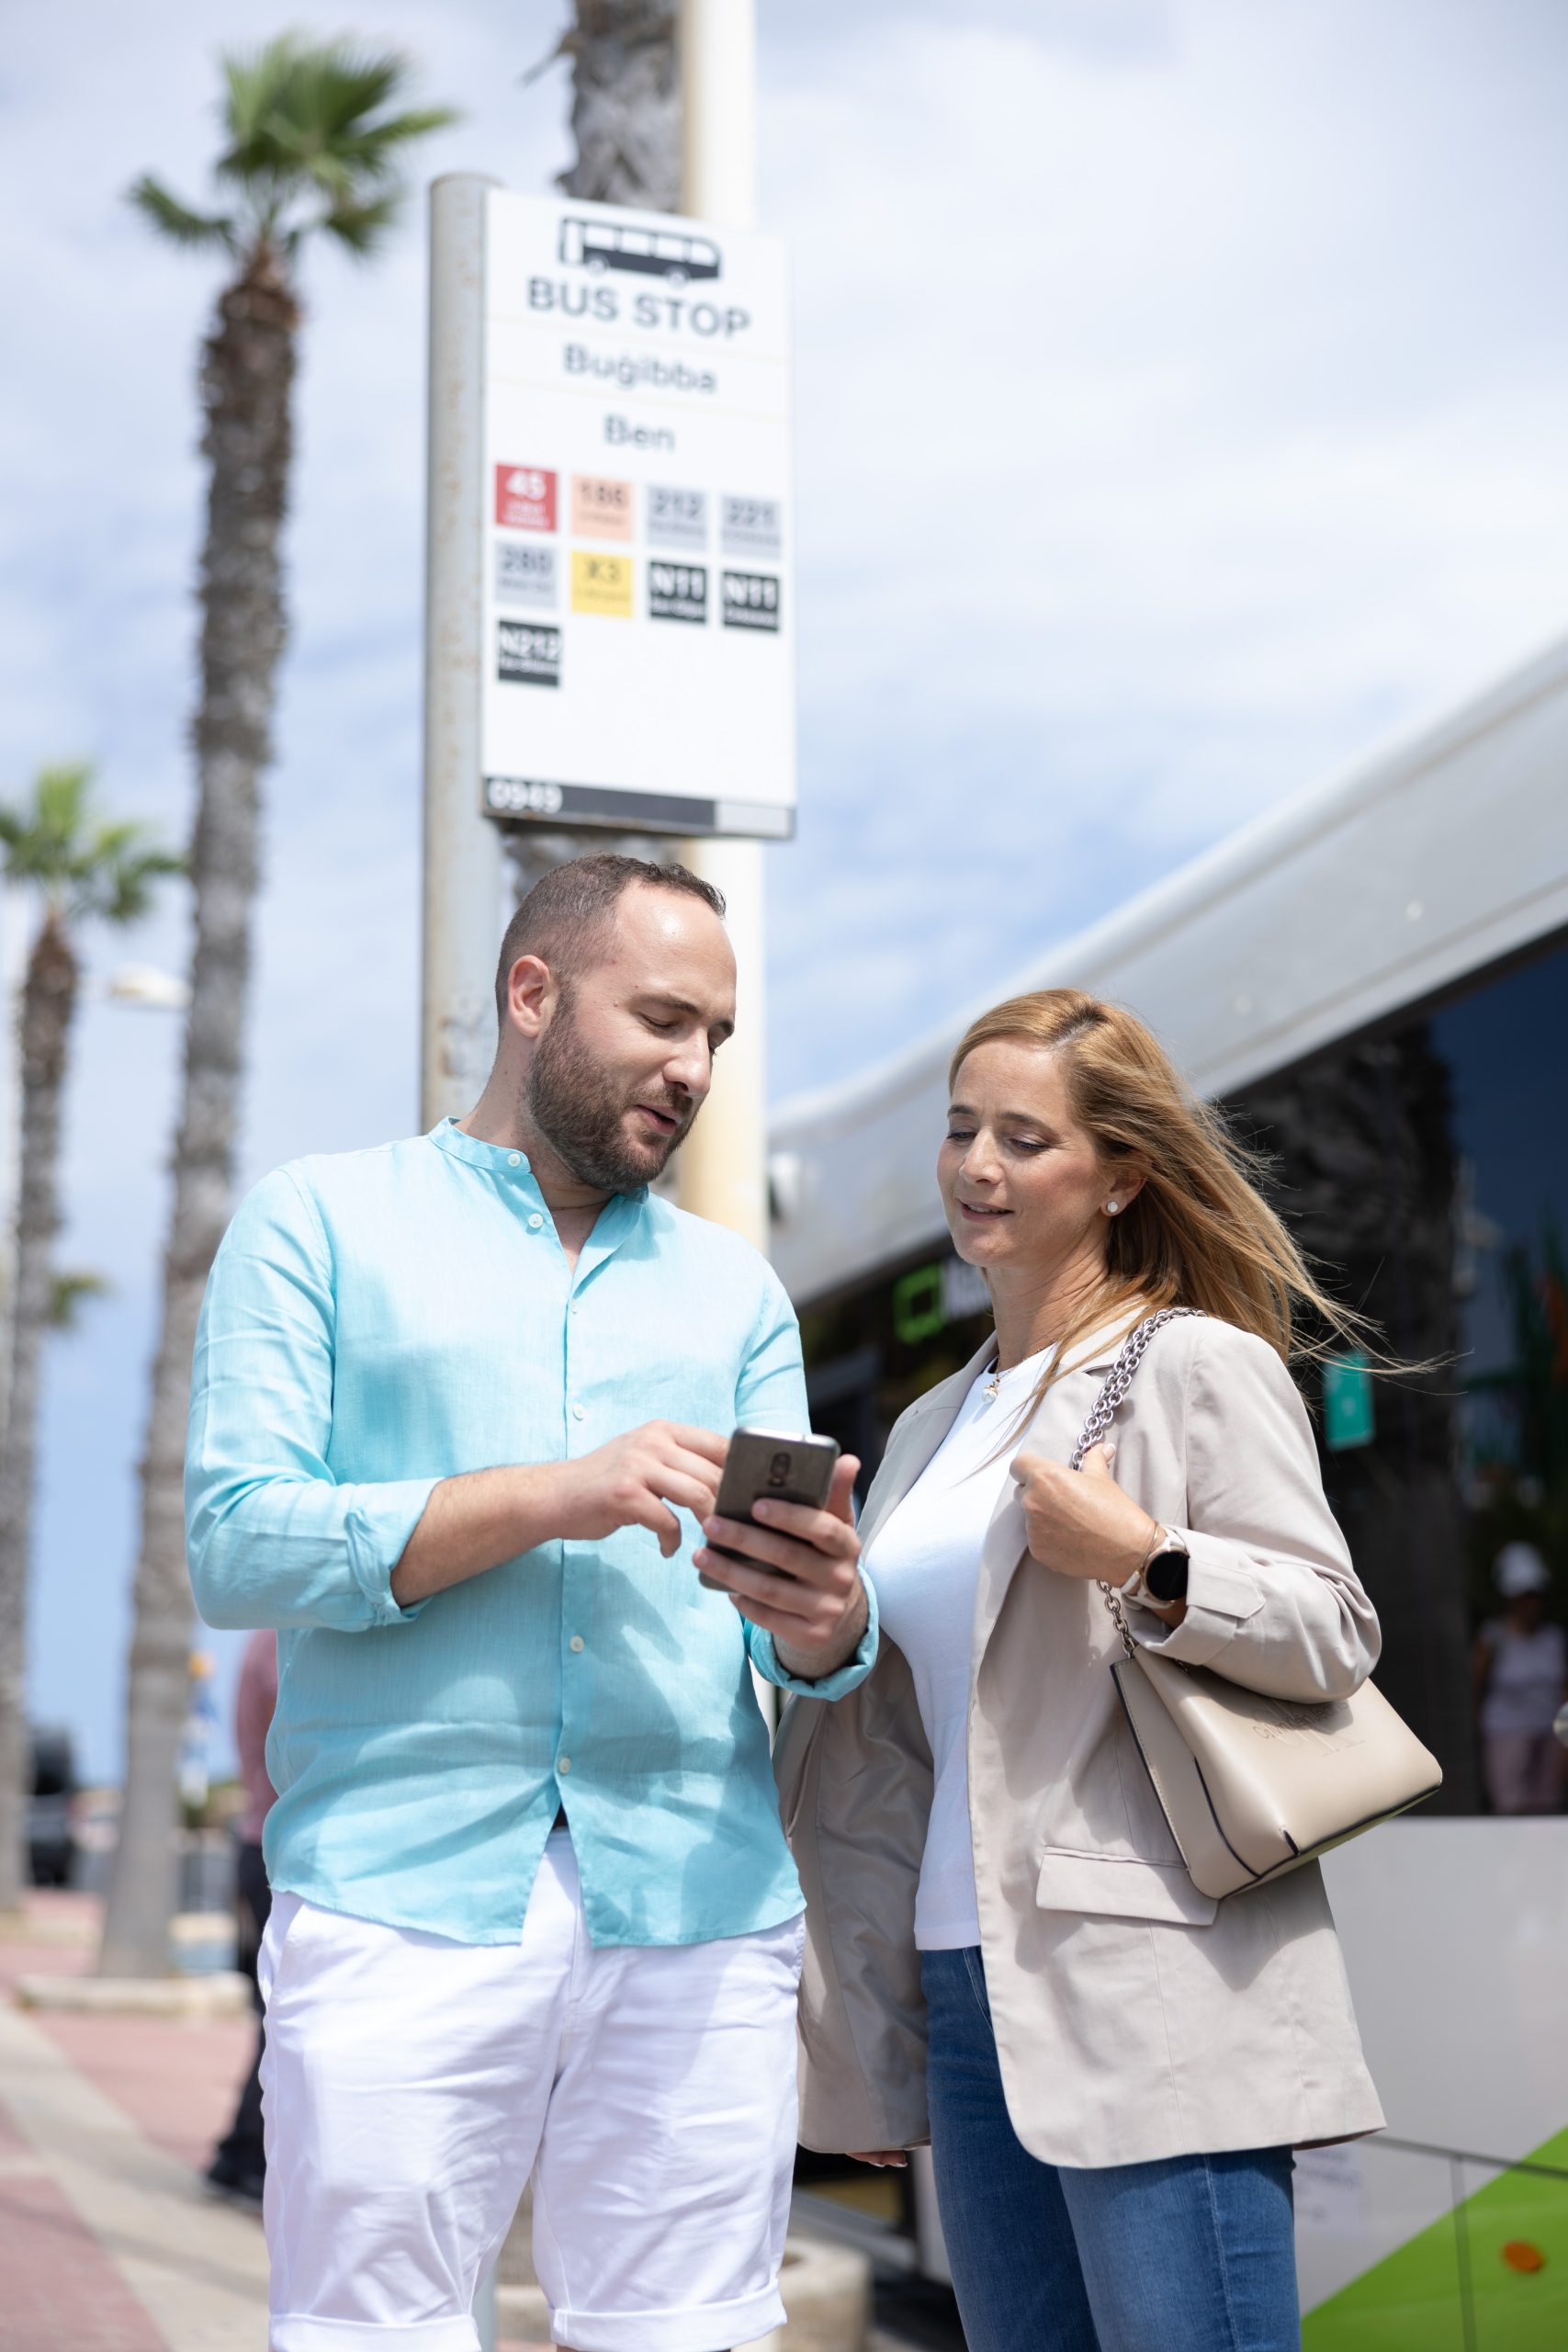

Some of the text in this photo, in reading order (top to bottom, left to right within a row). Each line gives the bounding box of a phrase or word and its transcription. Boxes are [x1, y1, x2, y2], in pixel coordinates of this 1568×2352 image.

[526, 277, 750, 338] BUS STOP
[604, 414, 675, 452] Ben
[507, 467, 547, 501] 45
[653, 490, 704, 519] 212
[728, 500, 776, 528] 221
[650, 564, 705, 600] N11
[725, 575, 778, 610] N11
[500, 628, 561, 660] N212
